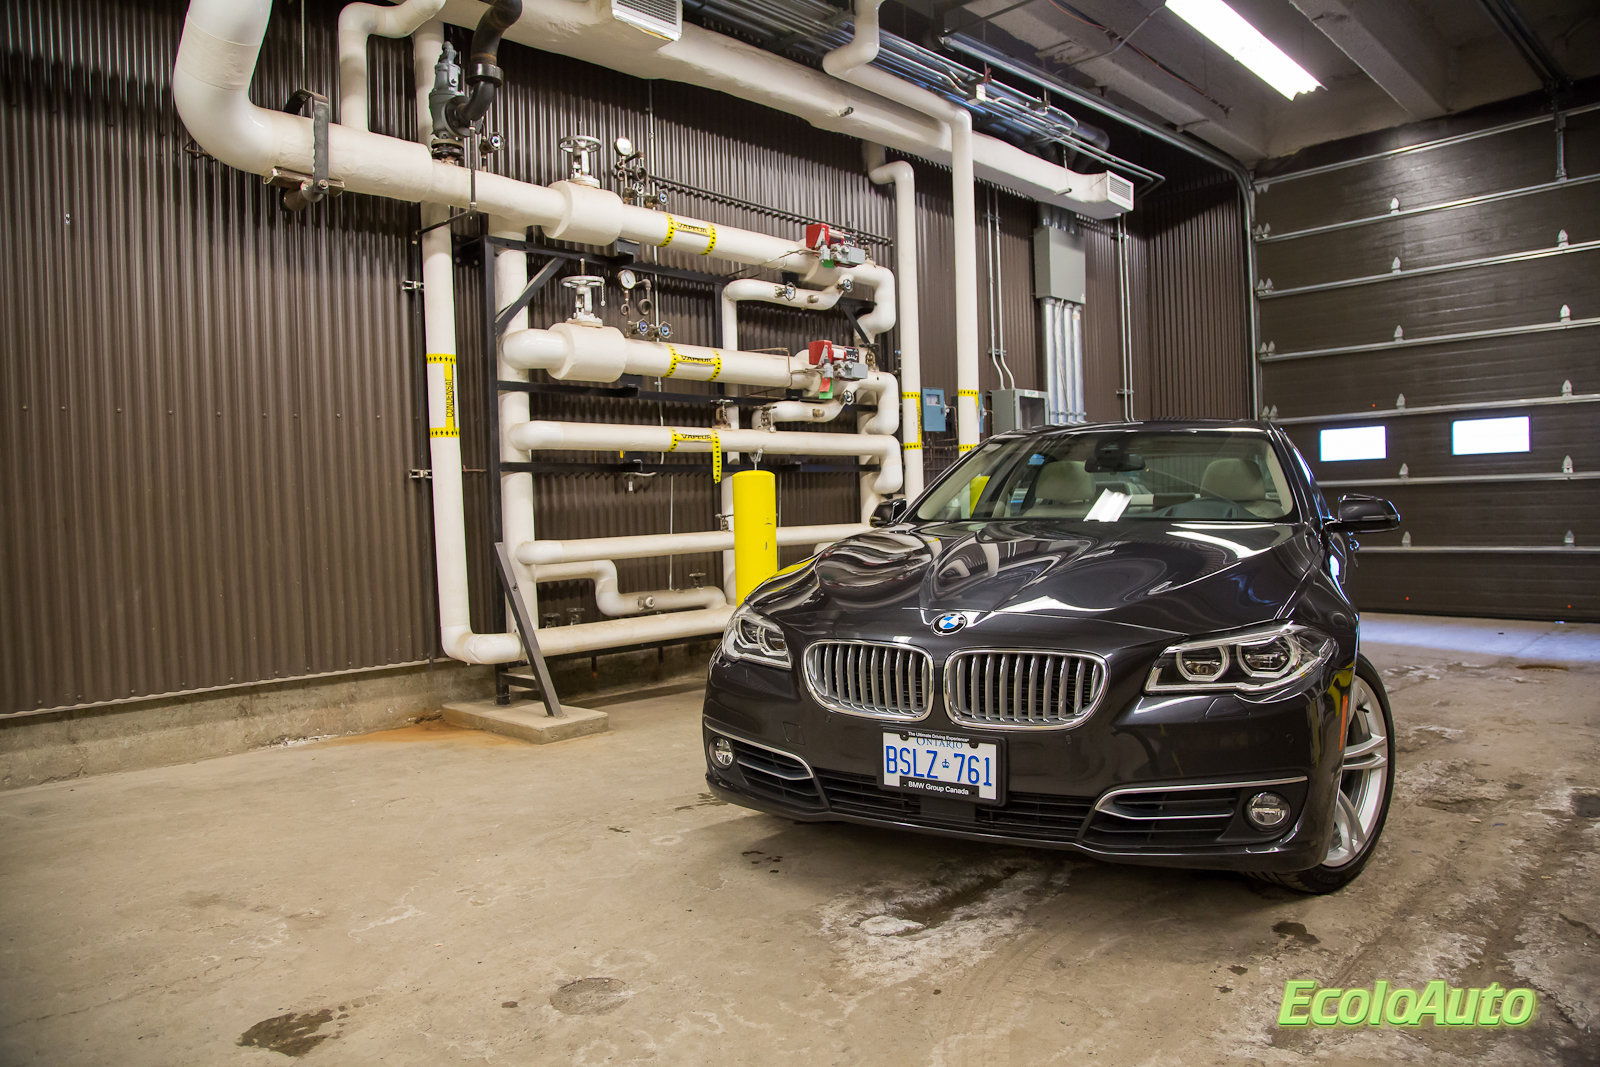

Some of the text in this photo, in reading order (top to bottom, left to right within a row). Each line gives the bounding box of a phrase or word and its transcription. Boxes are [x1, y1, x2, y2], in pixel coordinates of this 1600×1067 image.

[916, 738, 963, 749] ONTARIO
[885, 745, 992, 787] BSLZ 761
[908, 781, 969, 795] BMW Group Canada
